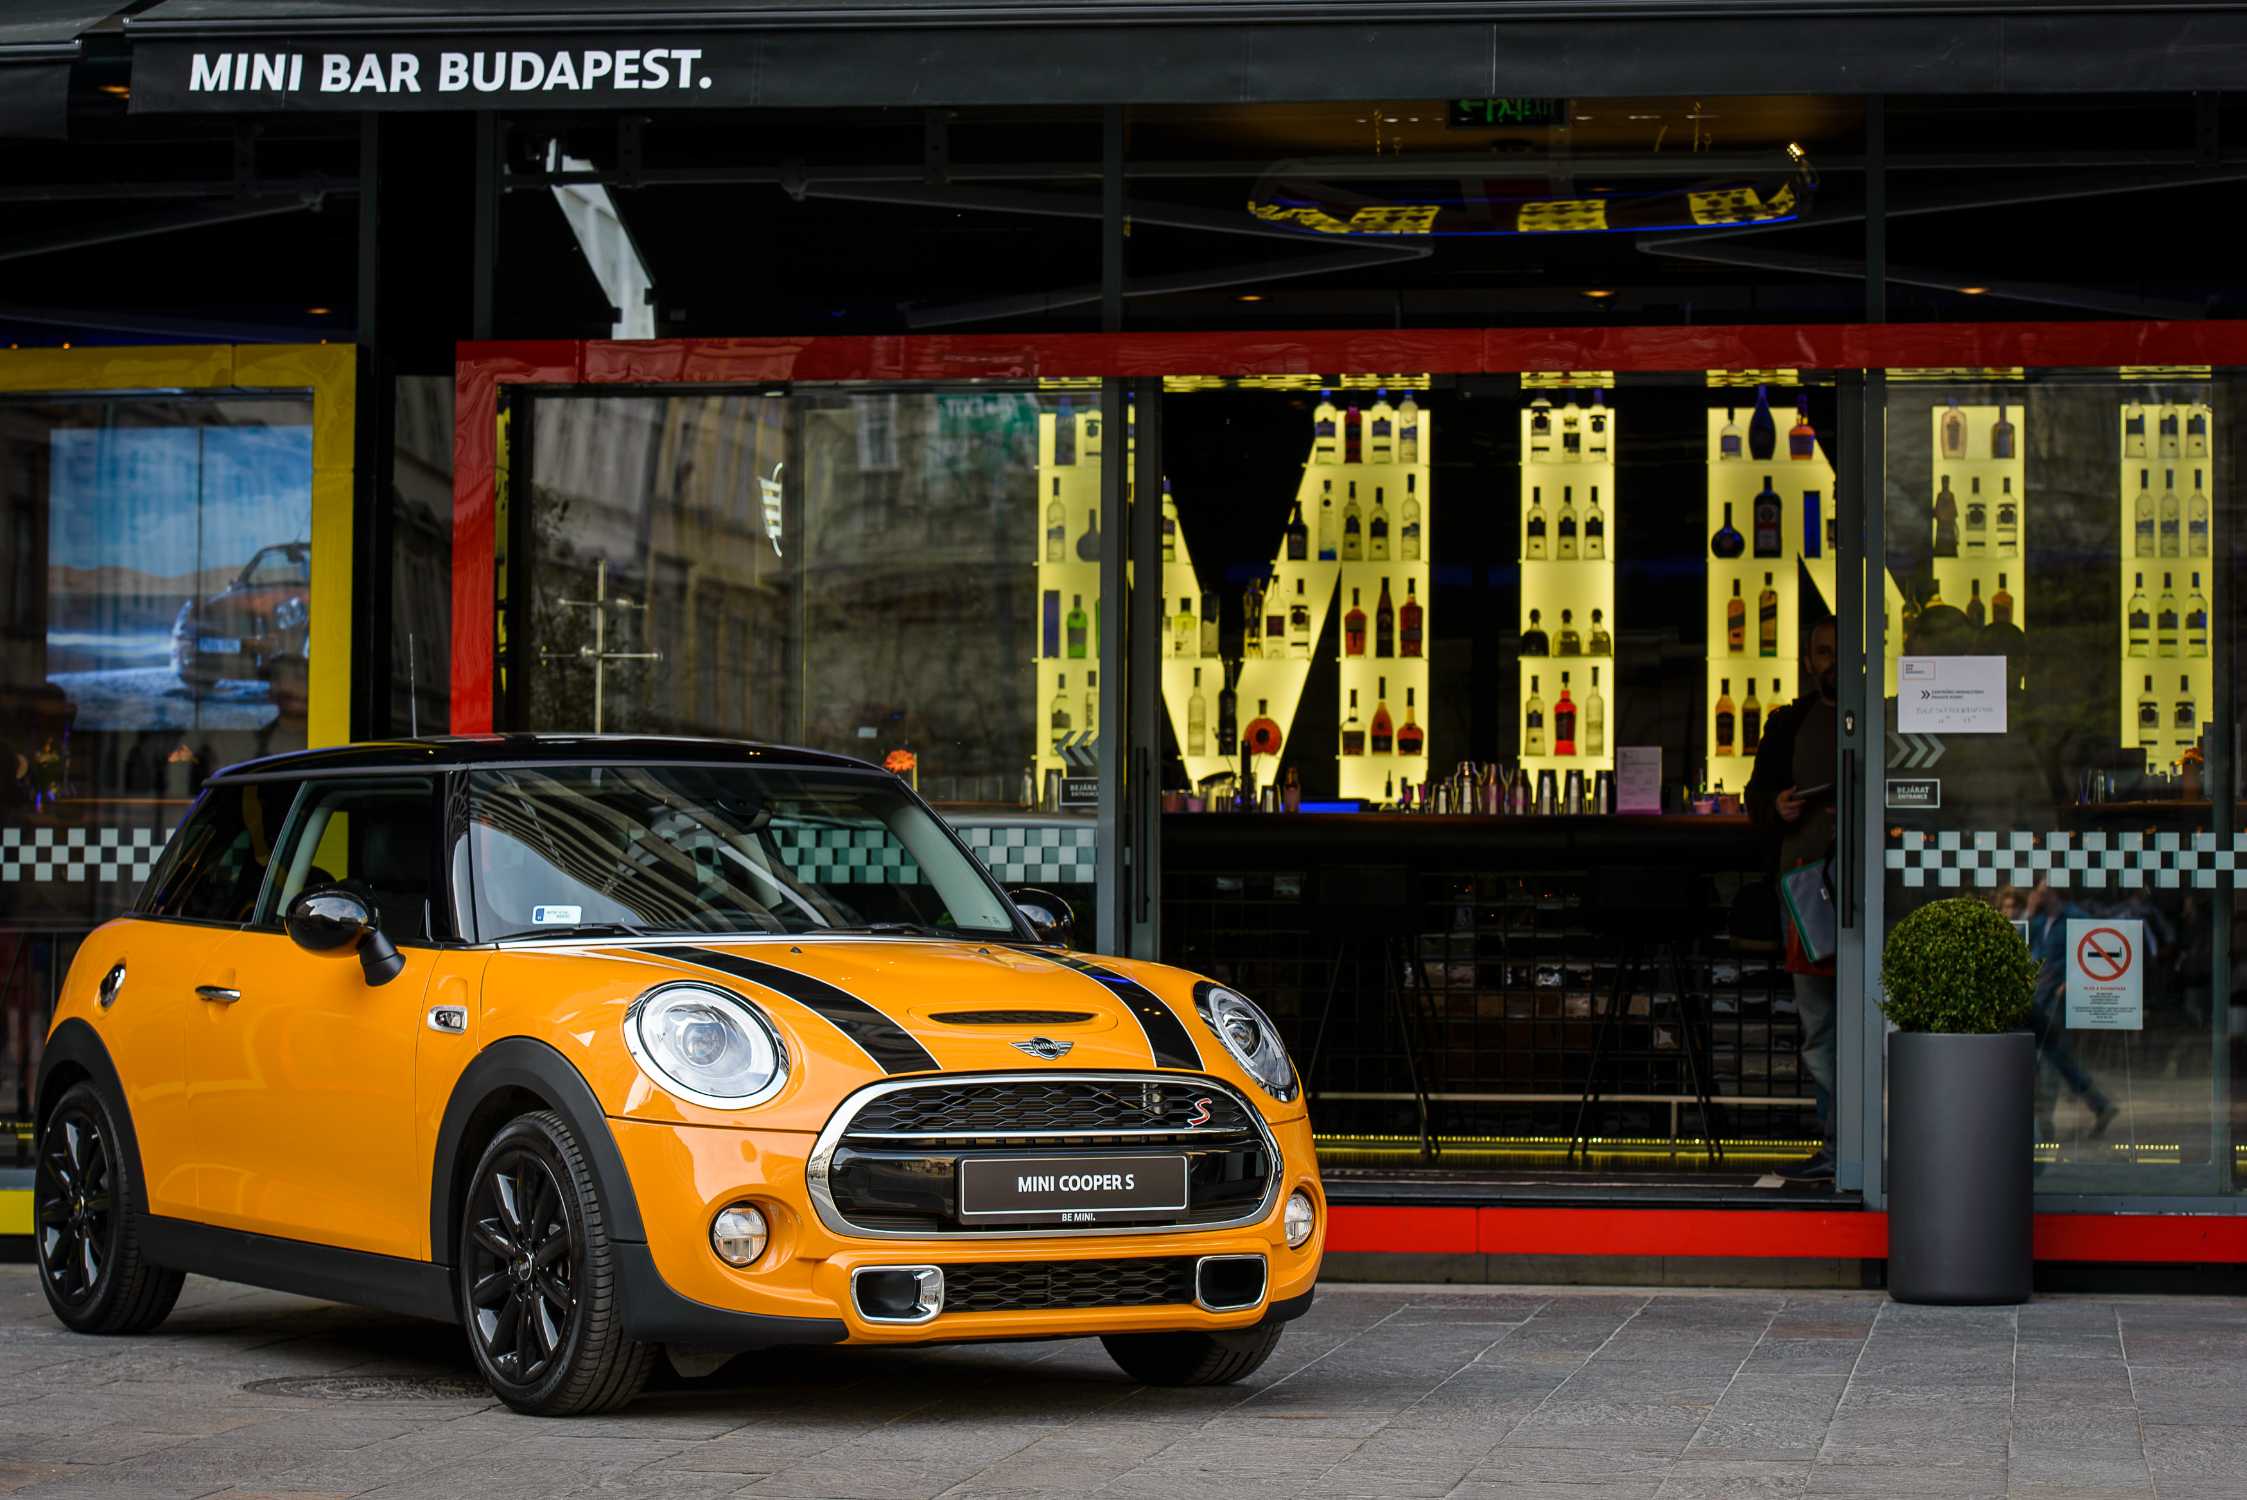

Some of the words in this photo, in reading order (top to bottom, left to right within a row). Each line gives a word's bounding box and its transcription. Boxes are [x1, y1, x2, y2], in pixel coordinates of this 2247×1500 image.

[189, 53, 302, 92] MINI
[320, 52, 422, 93] BAR
[438, 48, 714, 92] BUDAPEST.
[1070, 783, 1099, 791] BEJÁRA
[1034, 1042, 1057, 1050] MINI
[1186, 1097, 1213, 1126] S
[1018, 1175, 1055, 1193] MINI
[1059, 1174, 1122, 1191] COOPER
[1125, 1173, 1135, 1190] S
[1061, 1213, 1073, 1222] BE
[1074, 1212, 1096, 1222] MINI.
